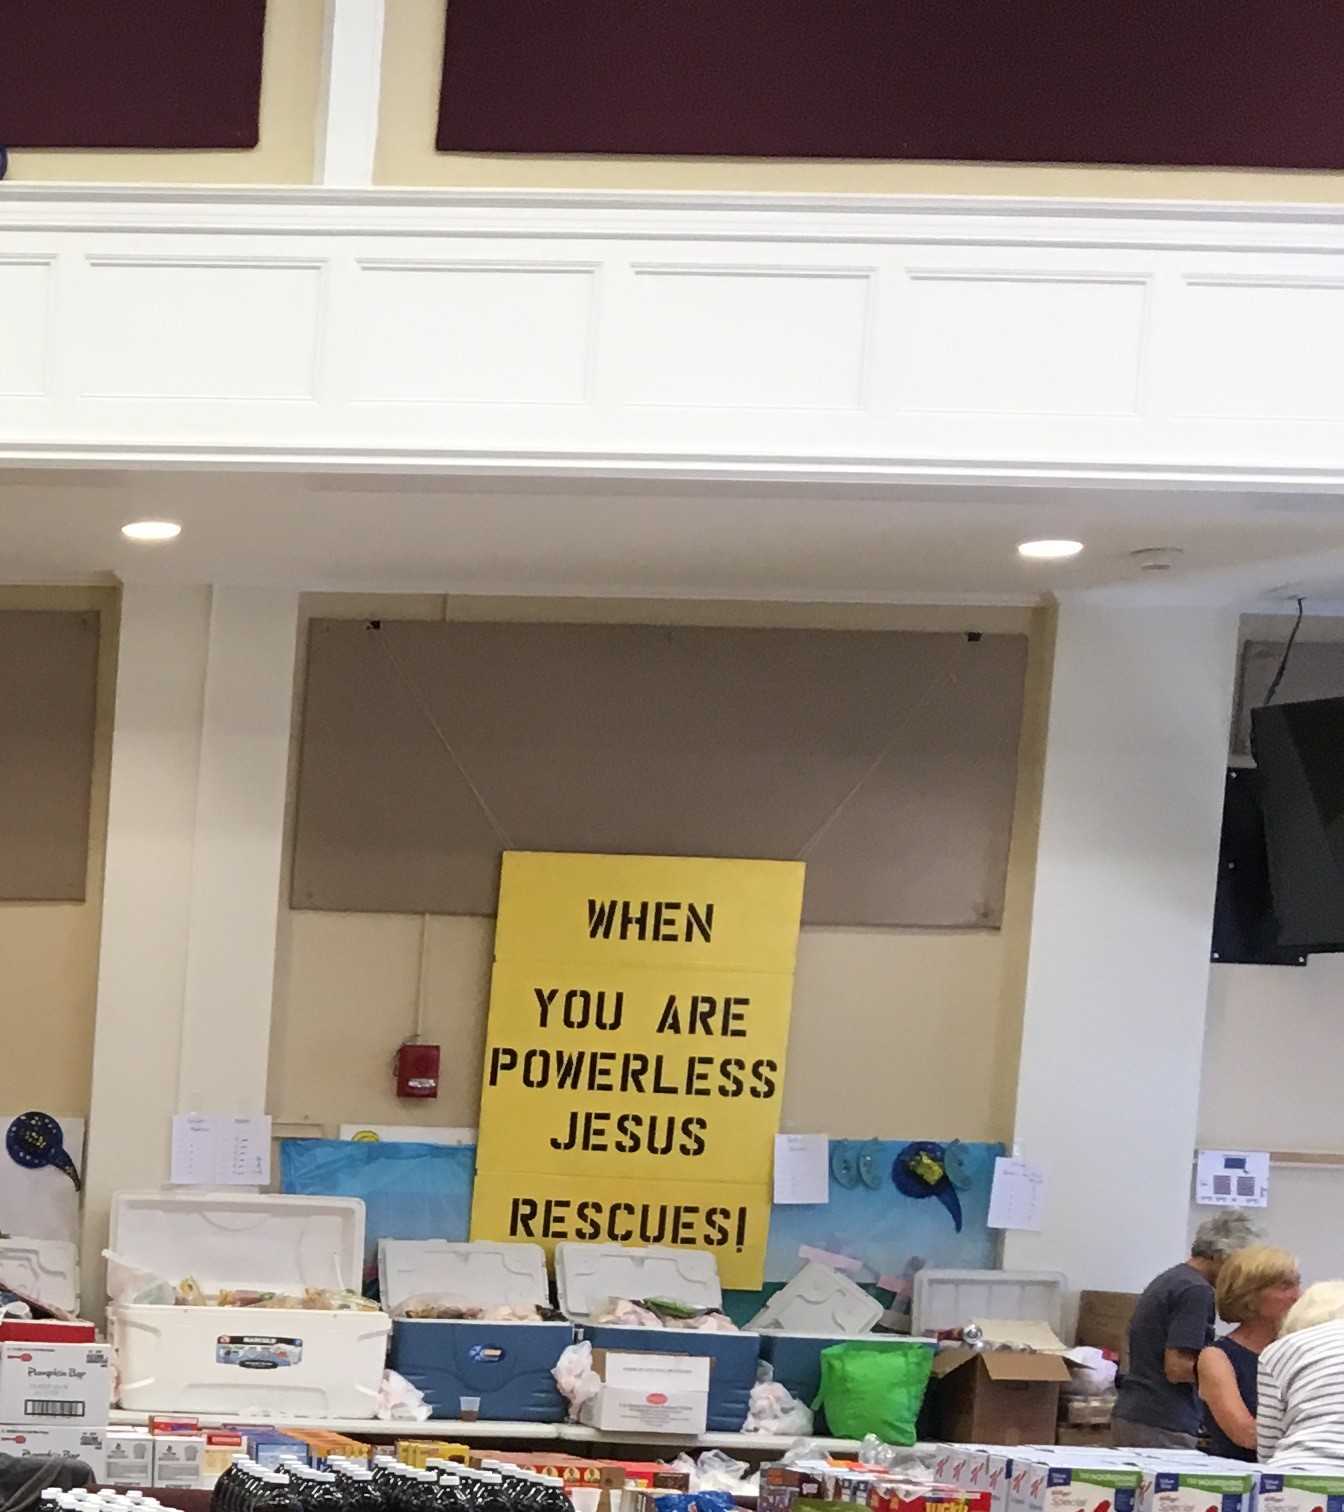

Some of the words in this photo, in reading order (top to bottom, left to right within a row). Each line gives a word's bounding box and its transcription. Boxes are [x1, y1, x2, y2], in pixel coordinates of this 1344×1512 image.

[588, 899, 713, 943] WHEN
[534, 988, 623, 1030] YOU
[657, 995, 749, 1038] ARE
[489, 1047, 779, 1099] POWERLESS
[549, 1112, 707, 1156] JESUS
[509, 1198, 746, 1253] RESCUES!
[27, 1366, 67, 1378] Pumpkin
[935, 1455, 949, 1477] K
[953, 1459, 966, 1481] K
[970, 1462, 984, 1485] K
[989, 1467, 1003, 1490] K
[1013, 1470, 1027, 1493] K
[1030, 1476, 1045, 1498] K
